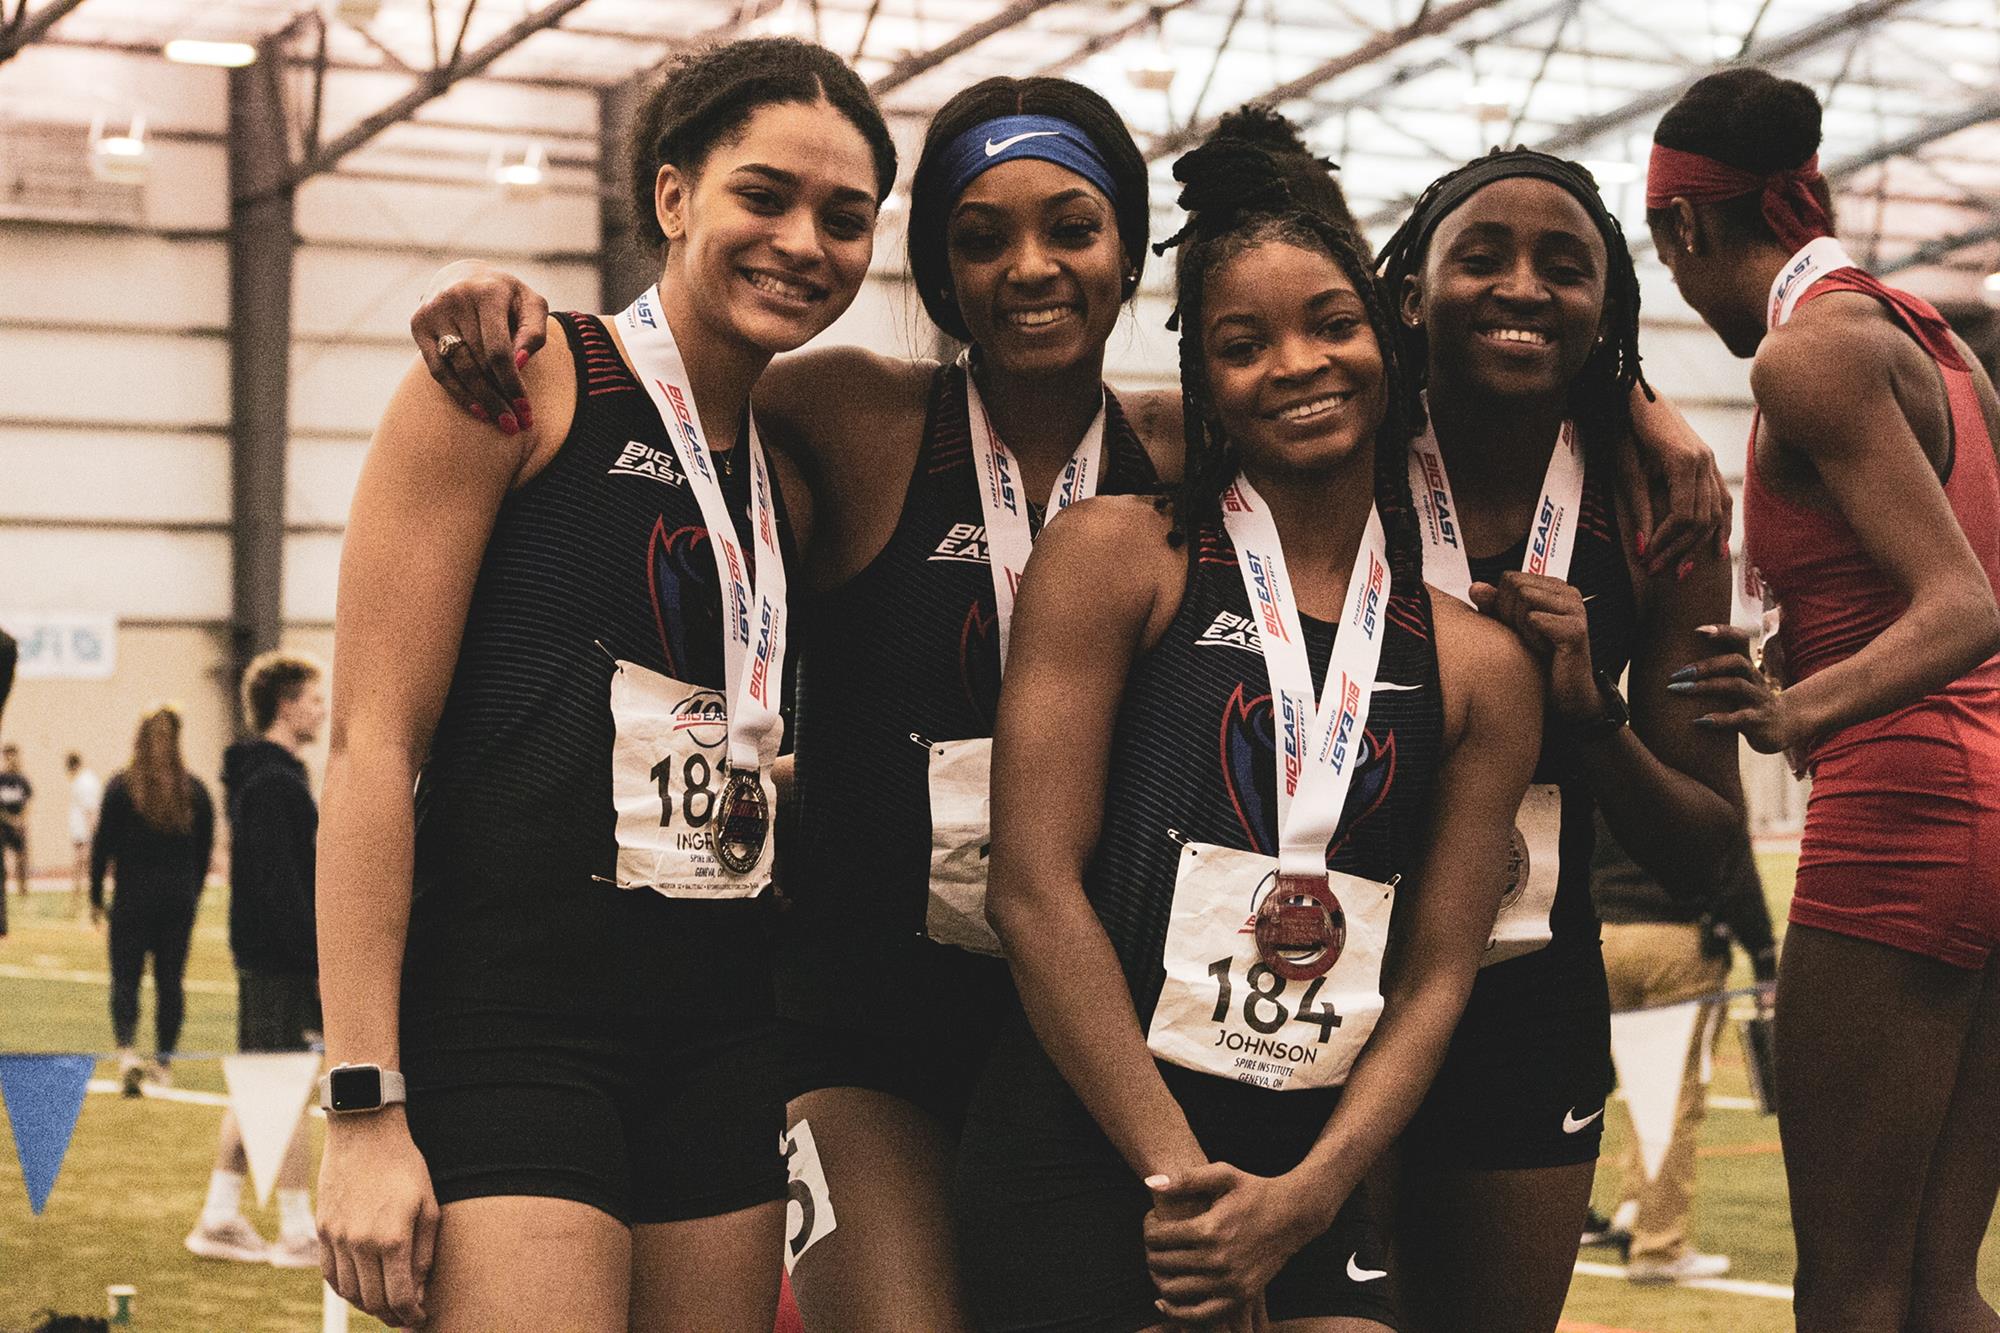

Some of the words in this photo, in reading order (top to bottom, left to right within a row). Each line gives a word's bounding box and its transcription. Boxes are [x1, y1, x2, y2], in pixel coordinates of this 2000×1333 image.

[623, 440, 673, 466] BIG
[667, 383, 692, 424] BIG
[682, 421, 712, 484] EAST
[614, 454, 687, 486] EAST
[995, 451, 1018, 516] EAST
[1423, 452, 1444, 491] BIG
[1433, 489, 1458, 550] EAST
[1533, 495, 1555, 558] EAST
[725, 539, 743, 583] BIG
[735, 580, 749, 649] EAST
[1246, 550, 1271, 604] EAST
[1369, 559, 1383, 598] BIG
[756, 594, 772, 662] EAST
[1202, 623, 1262, 651] EAS
[1259, 601, 1281, 639] BIG
[1362, 595, 1378, 641] EAST
[750, 656, 764, 701] BIG
[1346, 680, 1360, 717] BIG
[1281, 689, 1297, 758] EAST
[1331, 711, 1354, 776] EAST
[650, 753, 728, 828] 18
[1285, 754, 1299, 798] BIG
[676, 832, 715, 851] INGR
[1208, 956, 1343, 1044] 184
[1215, 1029, 1318, 1065] JOHNSON
[1234, 1057, 1257, 1071] SPIRE
[1257, 1062, 1294, 1077] INSTITUTE
[1238, 1072, 1270, 1089] GENEVA,
[1273, 1079, 1284, 1089] OH
